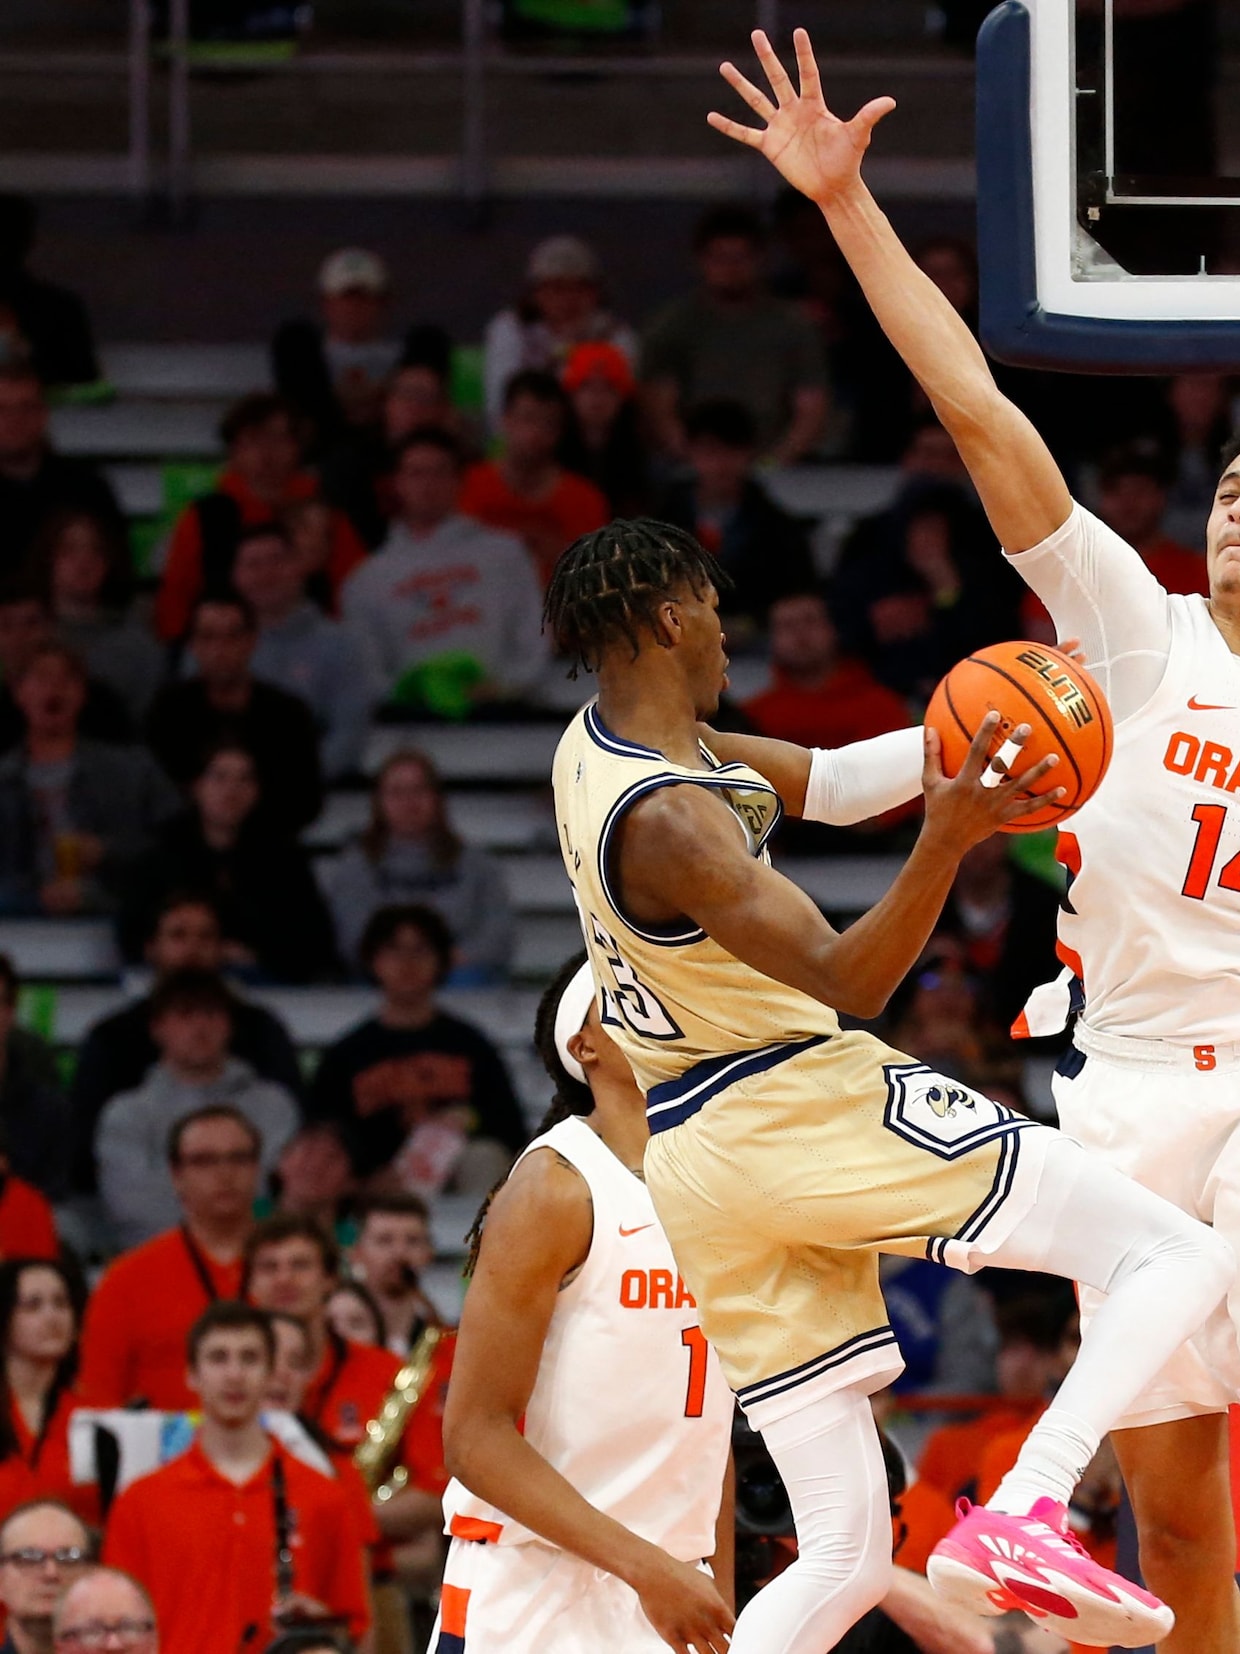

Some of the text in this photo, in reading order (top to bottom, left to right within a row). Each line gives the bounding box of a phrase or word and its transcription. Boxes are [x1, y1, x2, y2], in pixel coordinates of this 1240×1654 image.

[1015, 649, 1093, 729] ELITE
[588, 910, 686, 1041] 3
[1193, 1045, 1217, 1071] S
[619, 1269, 697, 1309] ORA
[681, 1325, 708, 1418] 1
